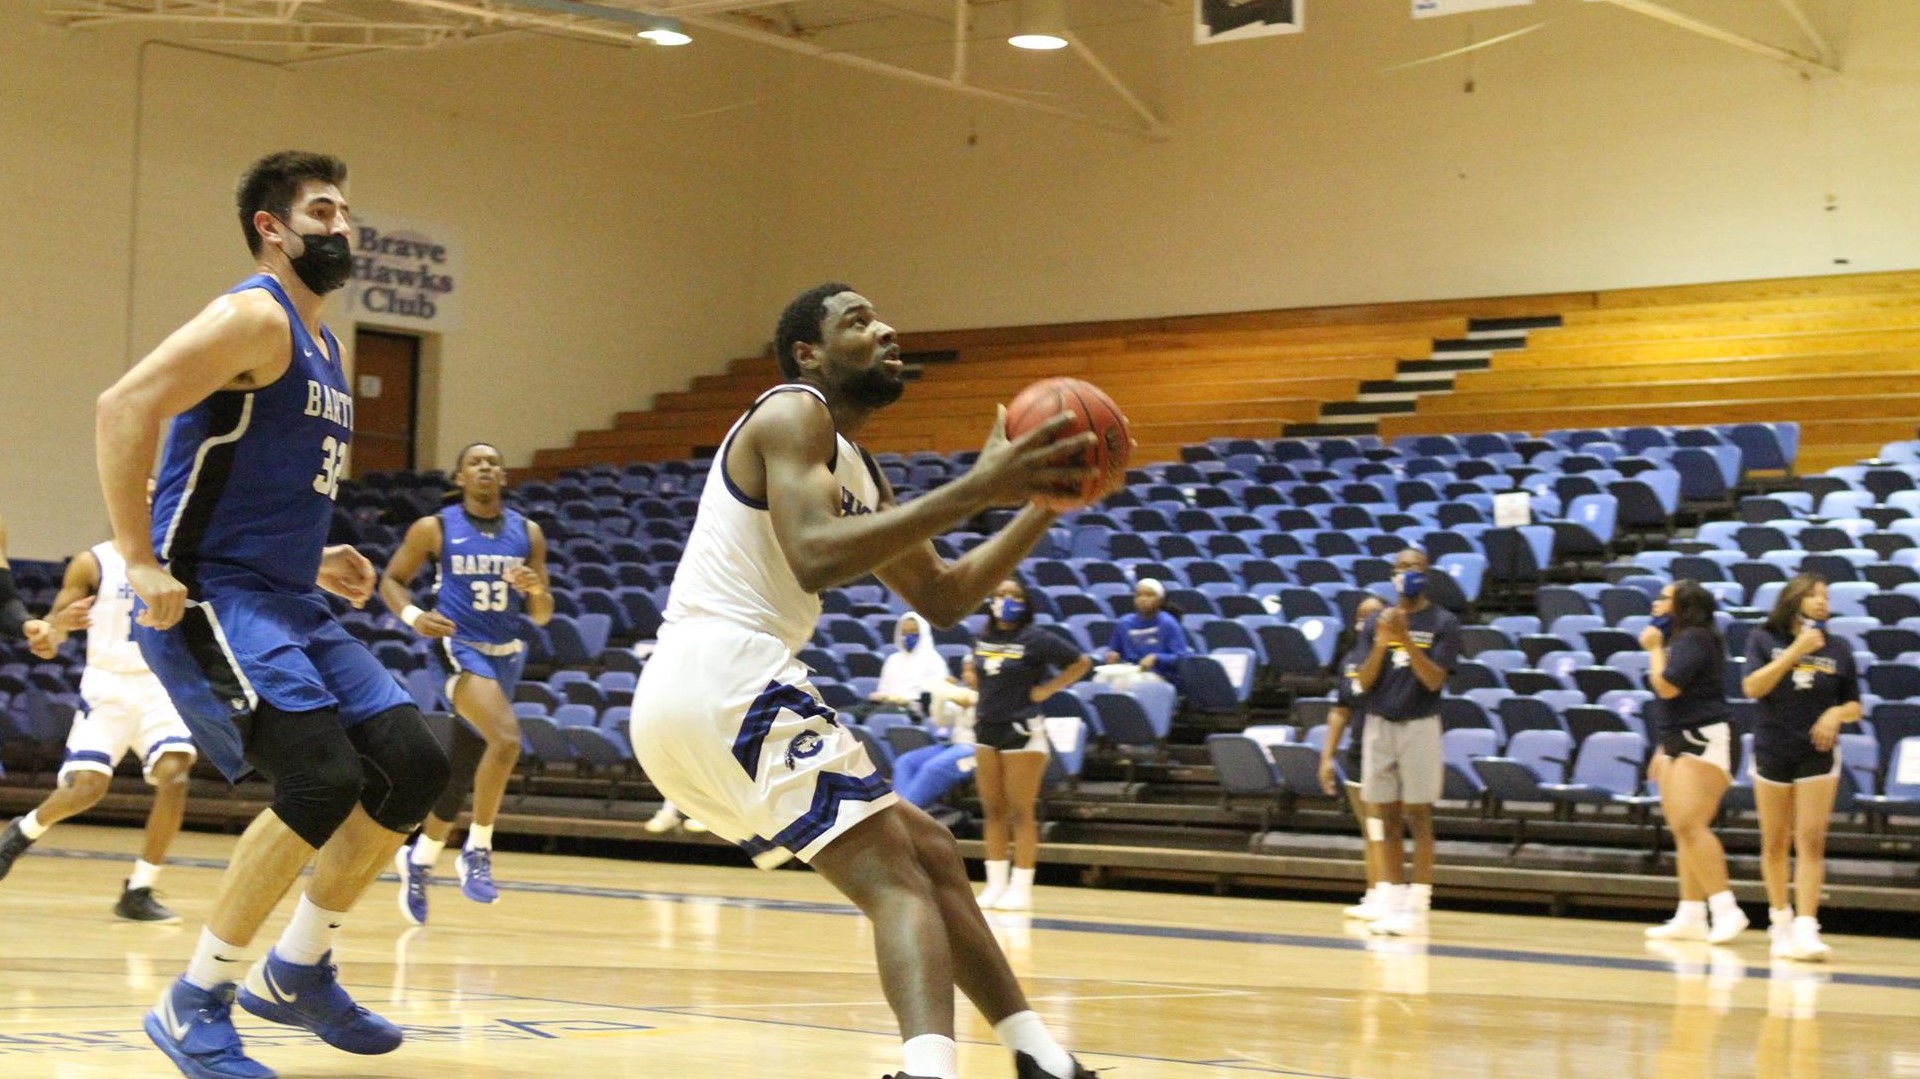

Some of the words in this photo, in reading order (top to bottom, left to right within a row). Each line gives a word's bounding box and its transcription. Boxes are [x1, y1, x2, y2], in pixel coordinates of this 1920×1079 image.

[357, 227, 446, 264] Brave
[351, 255, 453, 293] Hawks
[363, 287, 436, 319] Club
[470, 580, 509, 612] 33
